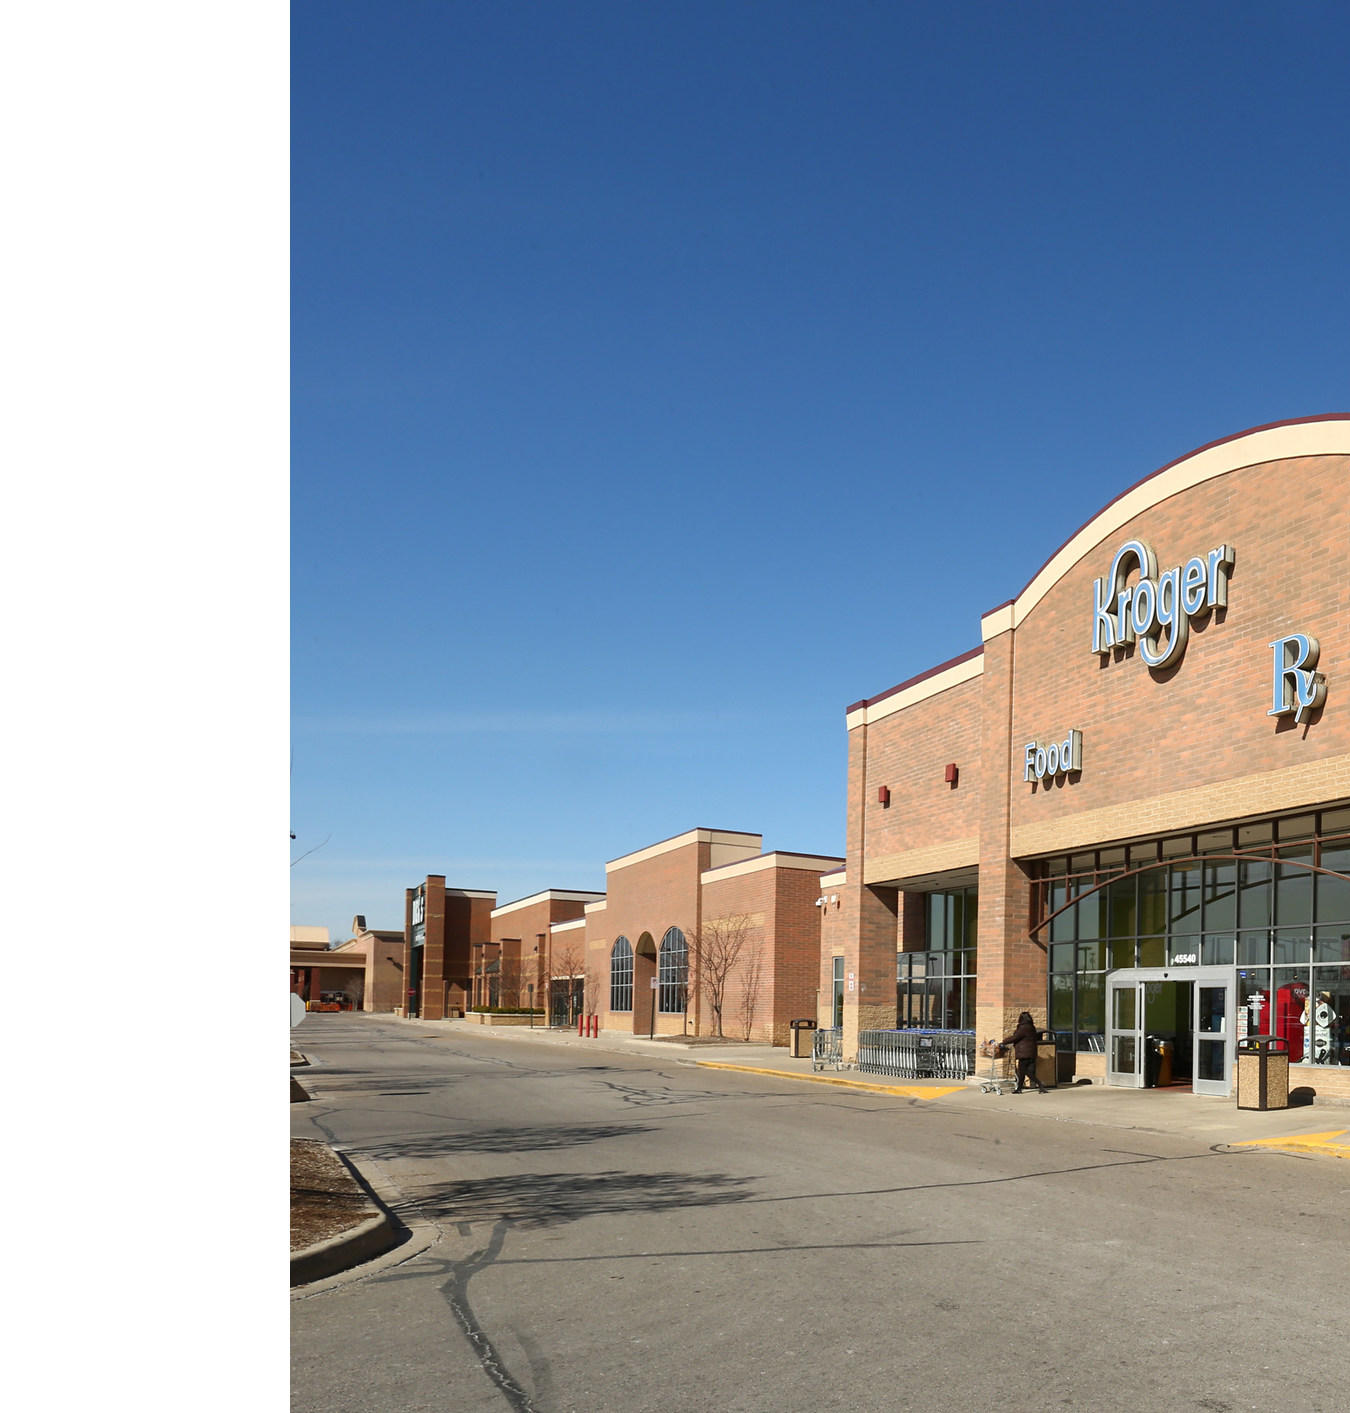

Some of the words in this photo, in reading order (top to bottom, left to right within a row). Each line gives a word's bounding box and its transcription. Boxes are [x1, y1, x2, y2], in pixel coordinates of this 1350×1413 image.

[1091, 540, 1228, 667] Kroger
[1024, 729, 1076, 782] Food
[1174, 953, 1196, 964] 45540
